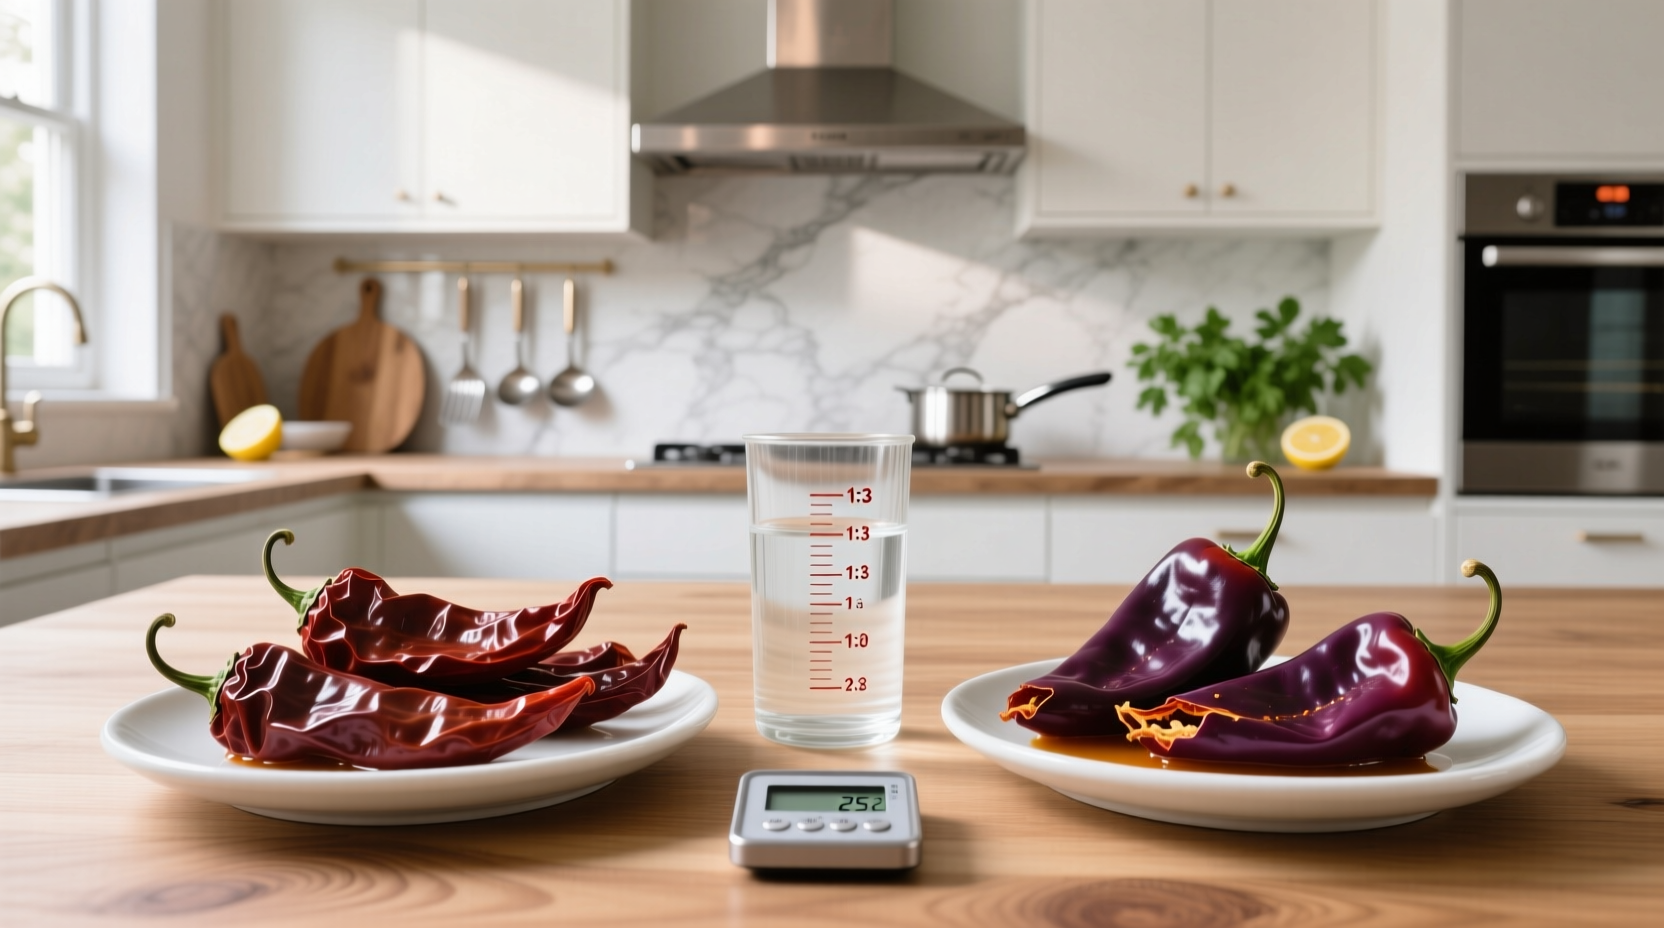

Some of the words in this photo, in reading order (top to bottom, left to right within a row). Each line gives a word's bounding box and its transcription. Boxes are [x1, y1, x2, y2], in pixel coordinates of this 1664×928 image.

[847, 487, 872, 503] 1:3
[846, 526, 870, 540] 1:3
[846, 565, 869, 580] 1:3
[845, 677, 866, 692] 2.8
[838, 796, 886, 812] 252
